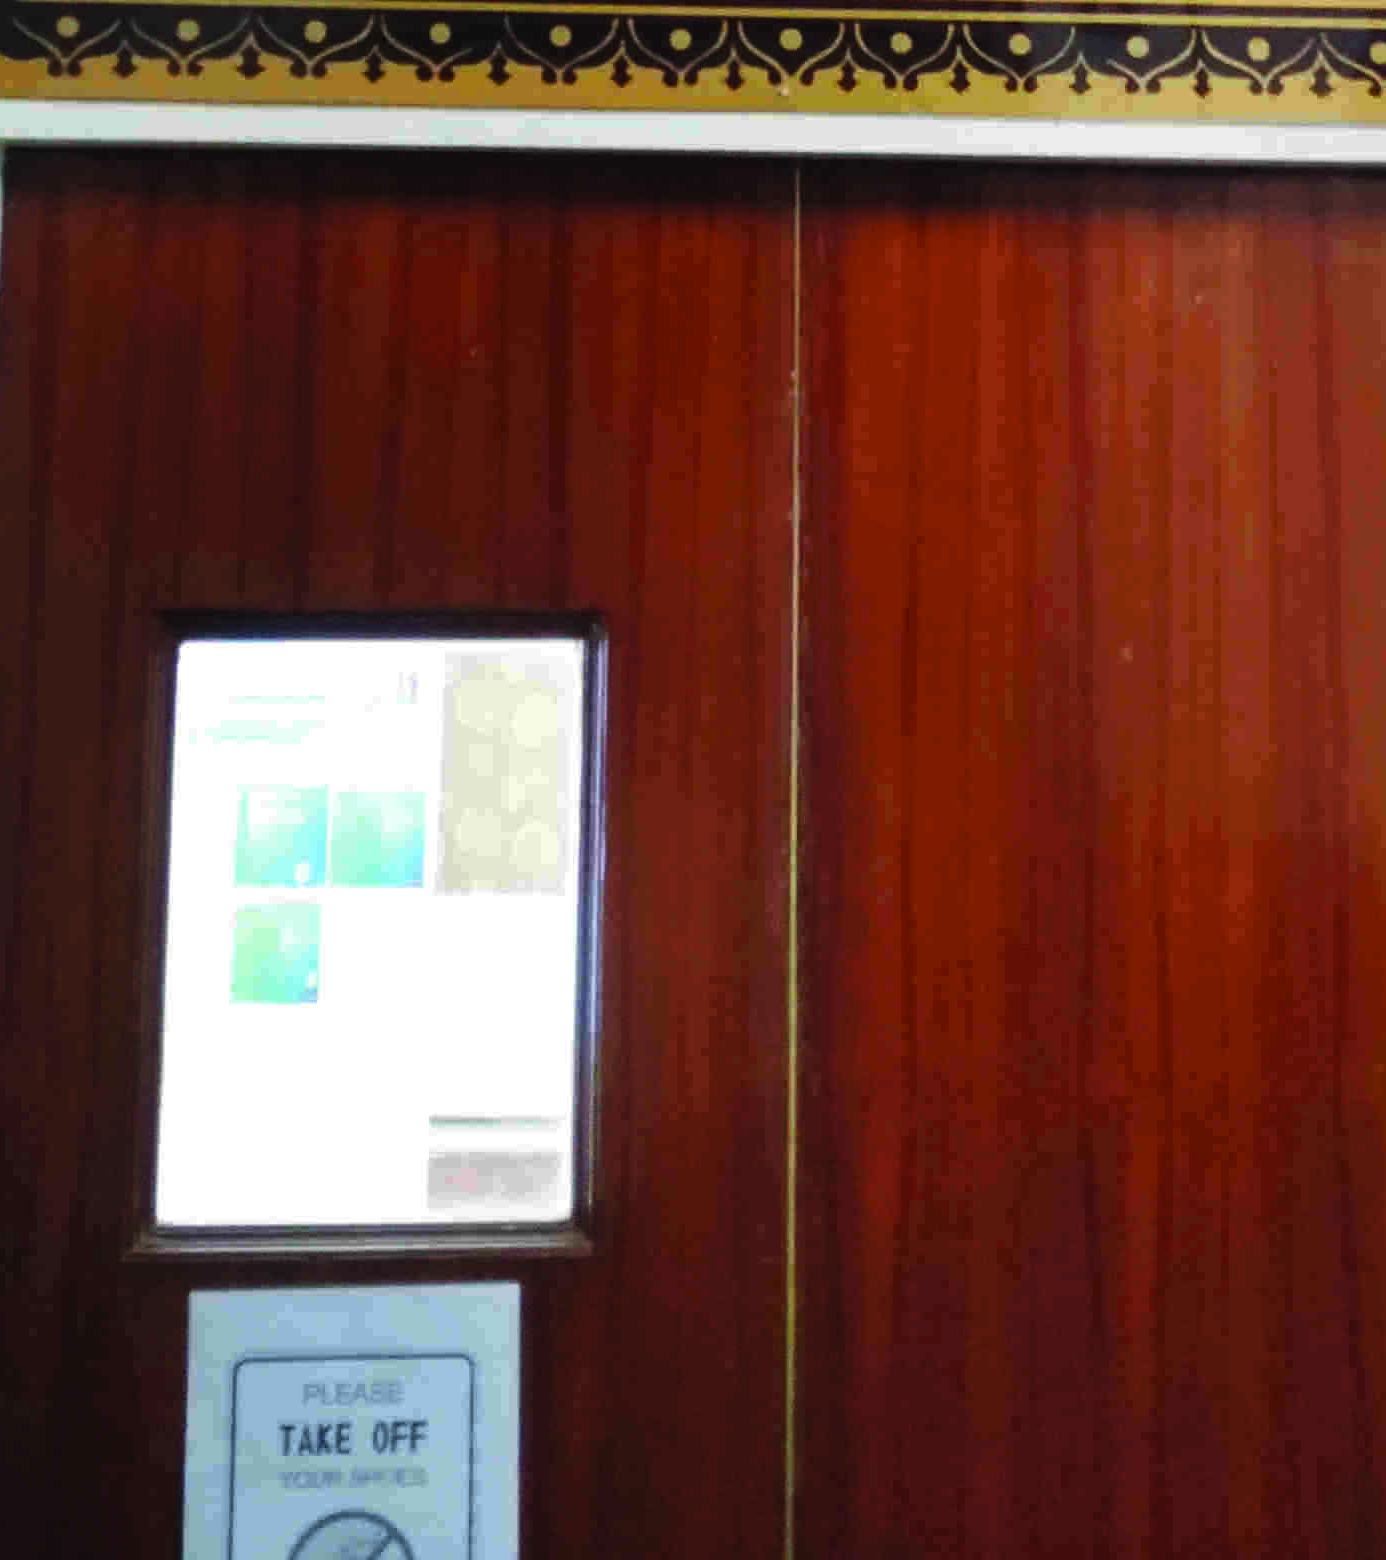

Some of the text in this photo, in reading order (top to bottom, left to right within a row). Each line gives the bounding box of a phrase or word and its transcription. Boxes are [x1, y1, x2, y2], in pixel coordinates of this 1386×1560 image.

[301, 1382, 406, 1407] PLEASE
[279, 1419, 429, 1456] TAKE OFF
